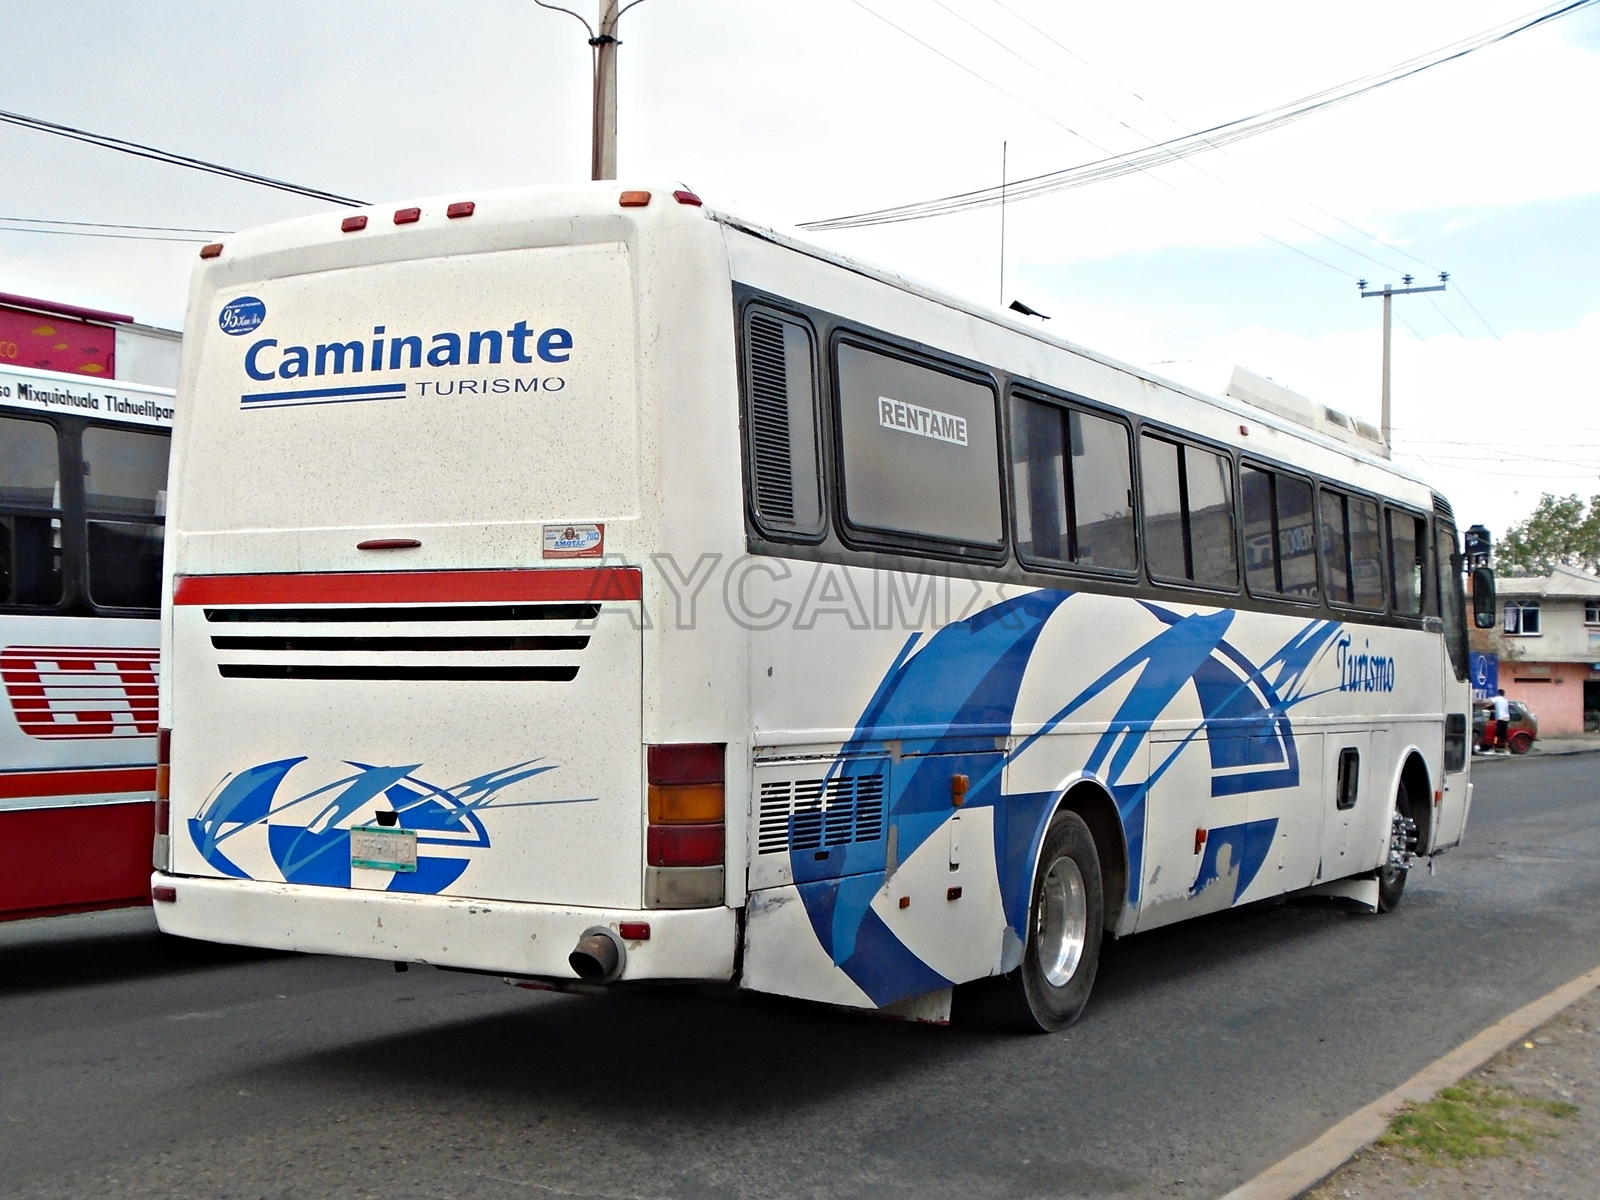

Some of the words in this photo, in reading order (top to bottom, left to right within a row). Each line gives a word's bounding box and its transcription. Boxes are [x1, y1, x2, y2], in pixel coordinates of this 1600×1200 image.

[221, 309, 240, 328] 95
[244, 320, 574, 381] Caminante
[17, 382, 99, 409] Mixquiahuala
[415, 377, 566, 396] TURISMO
[881, 400, 966, 442] RENTAME
[554, 540, 586, 548] AMOTAC
[1336, 633, 1395, 693] Turismo
